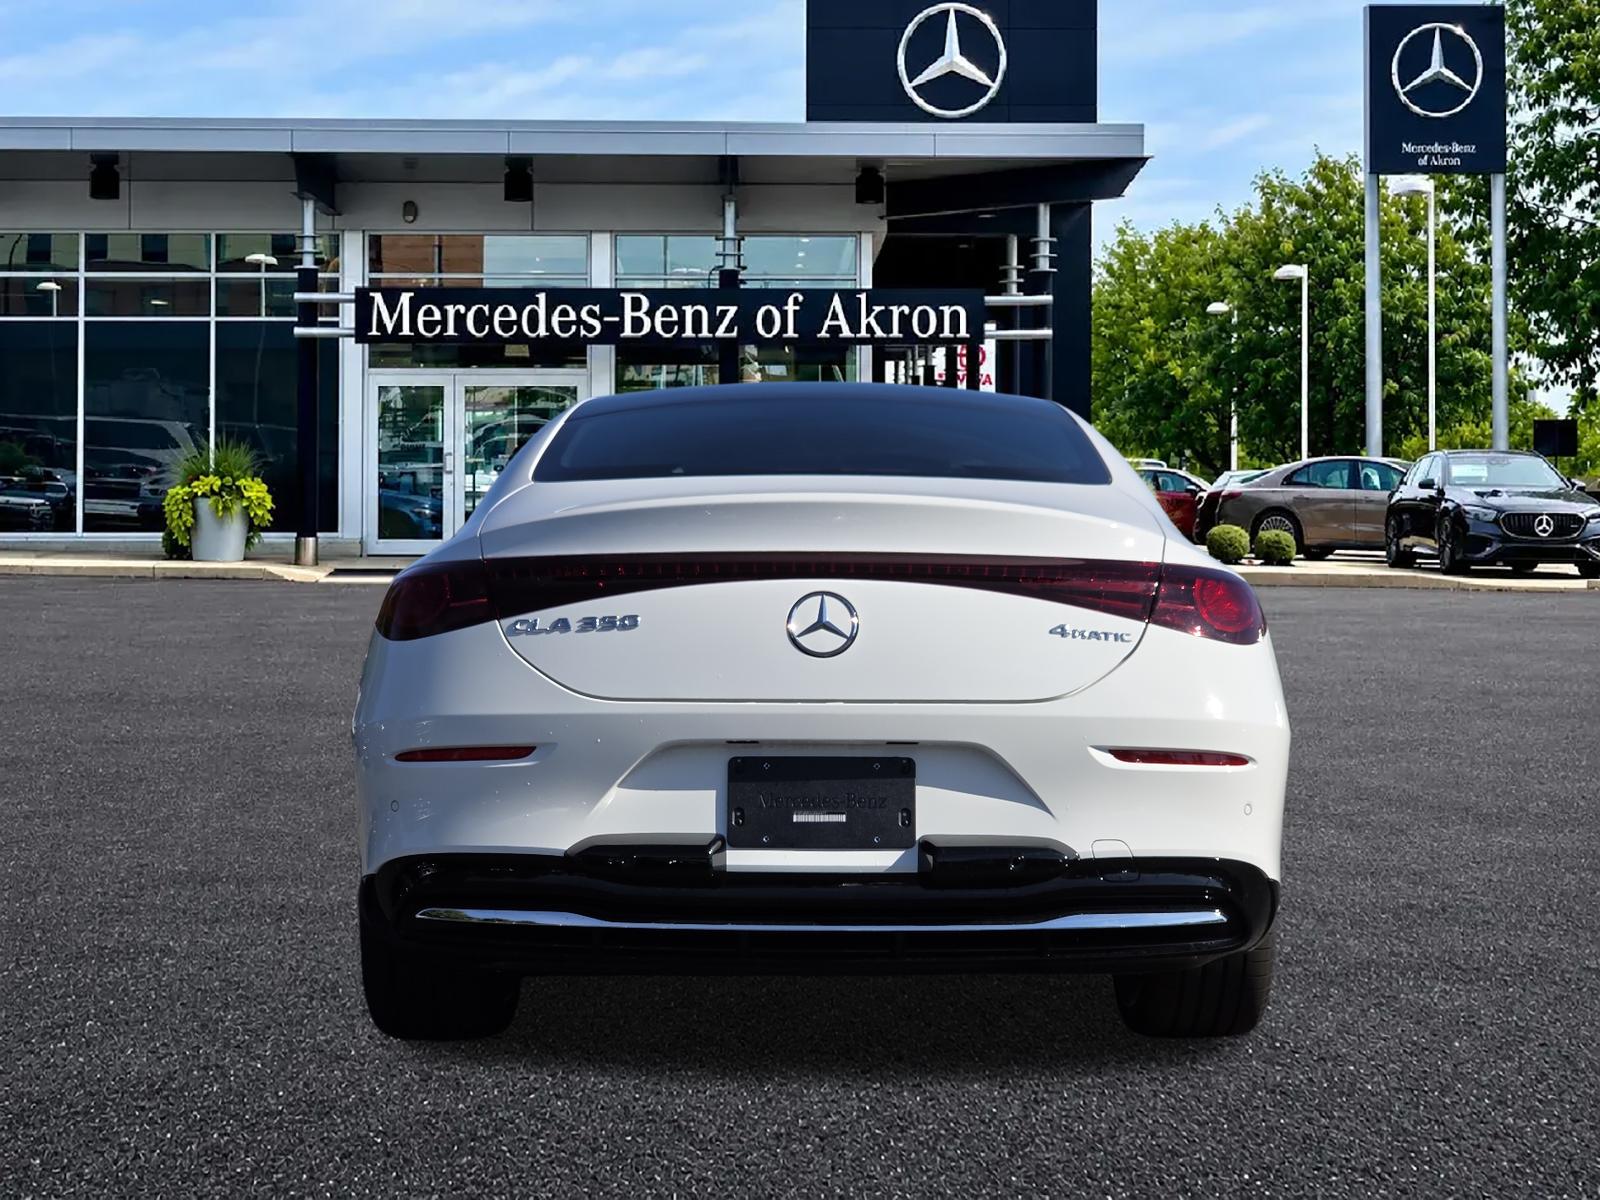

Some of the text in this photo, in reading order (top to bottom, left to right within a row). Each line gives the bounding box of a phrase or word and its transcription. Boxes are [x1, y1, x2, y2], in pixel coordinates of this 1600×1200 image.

[1401, 141, 1477, 154] Mercedes-Benz
[1417, 154, 1461, 166] of Akron
[367, 291, 971, 339] Mercedes-Benz of Akron
[505, 617, 572, 637] CLA
[758, 792, 888, 809] Mercedes-Benz
